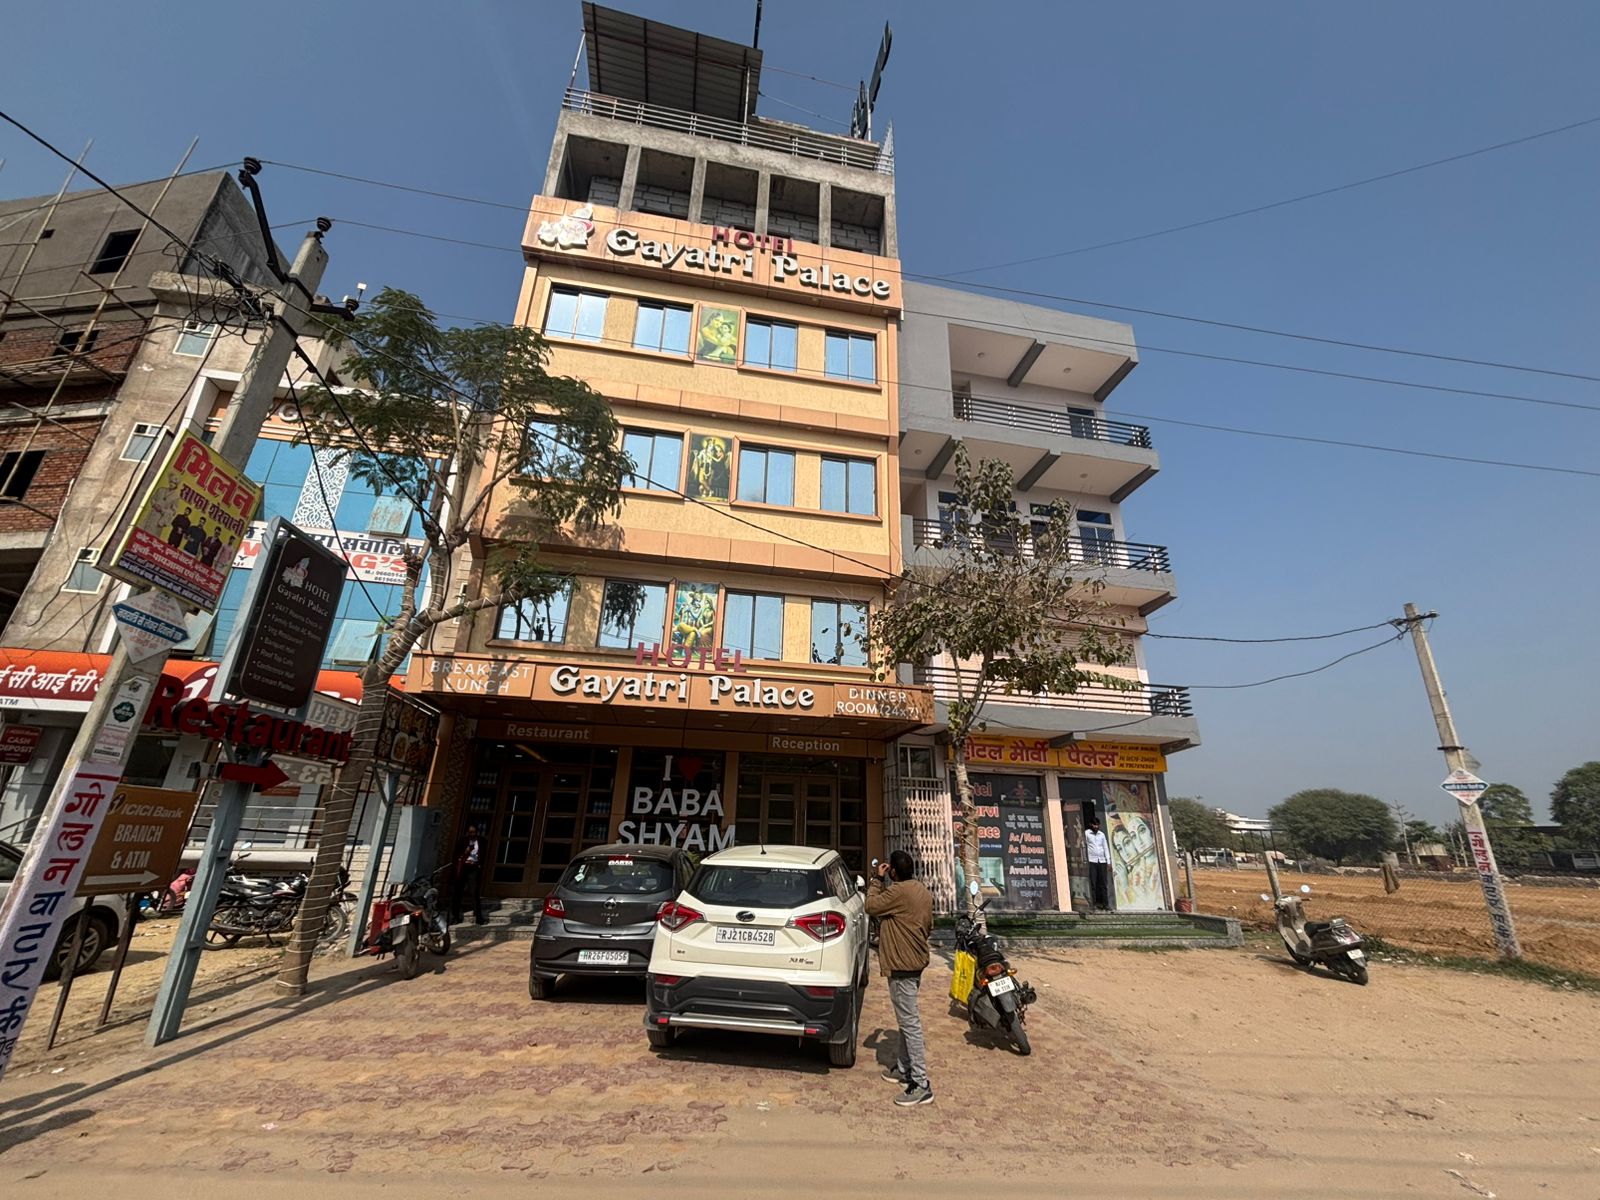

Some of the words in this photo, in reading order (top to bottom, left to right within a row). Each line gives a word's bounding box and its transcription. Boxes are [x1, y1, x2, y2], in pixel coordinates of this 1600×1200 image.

[712, 226, 795, 256] HOTEL
[607, 228, 753, 276] Gayatri
[772, 255, 890, 300] Palace
[174, 437, 254, 517] मिलन
[276, 584, 306, 605] Gayatri
[307, 599, 329, 616] Palace
[304, 581, 330, 601] HOTEL
[635, 642, 747, 672] HOTEL
[8, 665, 36, 689] सी
[32, 668, 76, 694] आई
[70, 669, 98, 693] सी
[431, 660, 531, 679] BREAKFAST
[446, 678, 510, 693] LUNCH
[550, 665, 686, 704] Gayatri
[708, 675, 815, 711] Palace
[849, 688, 907, 703] DINNER
[143, 673, 353, 763] Restaurant
[507, 724, 590, 740] Restaurant
[772, 737, 840, 752] Reception
[1066, 745, 1119, 768] पैलेस
[662, 755, 673, 781] I
[121, 803, 153, 816] ICICI
[153, 806, 184, 819] Bank
[632, 786, 725, 817] BABA
[113, 824, 164, 843] BRANCH
[618, 820, 737, 852] SHYAM
[111, 853, 121, 869] &
[123, 851, 151, 869] ATM
[722, 930, 774, 942] RJ21CB4528
